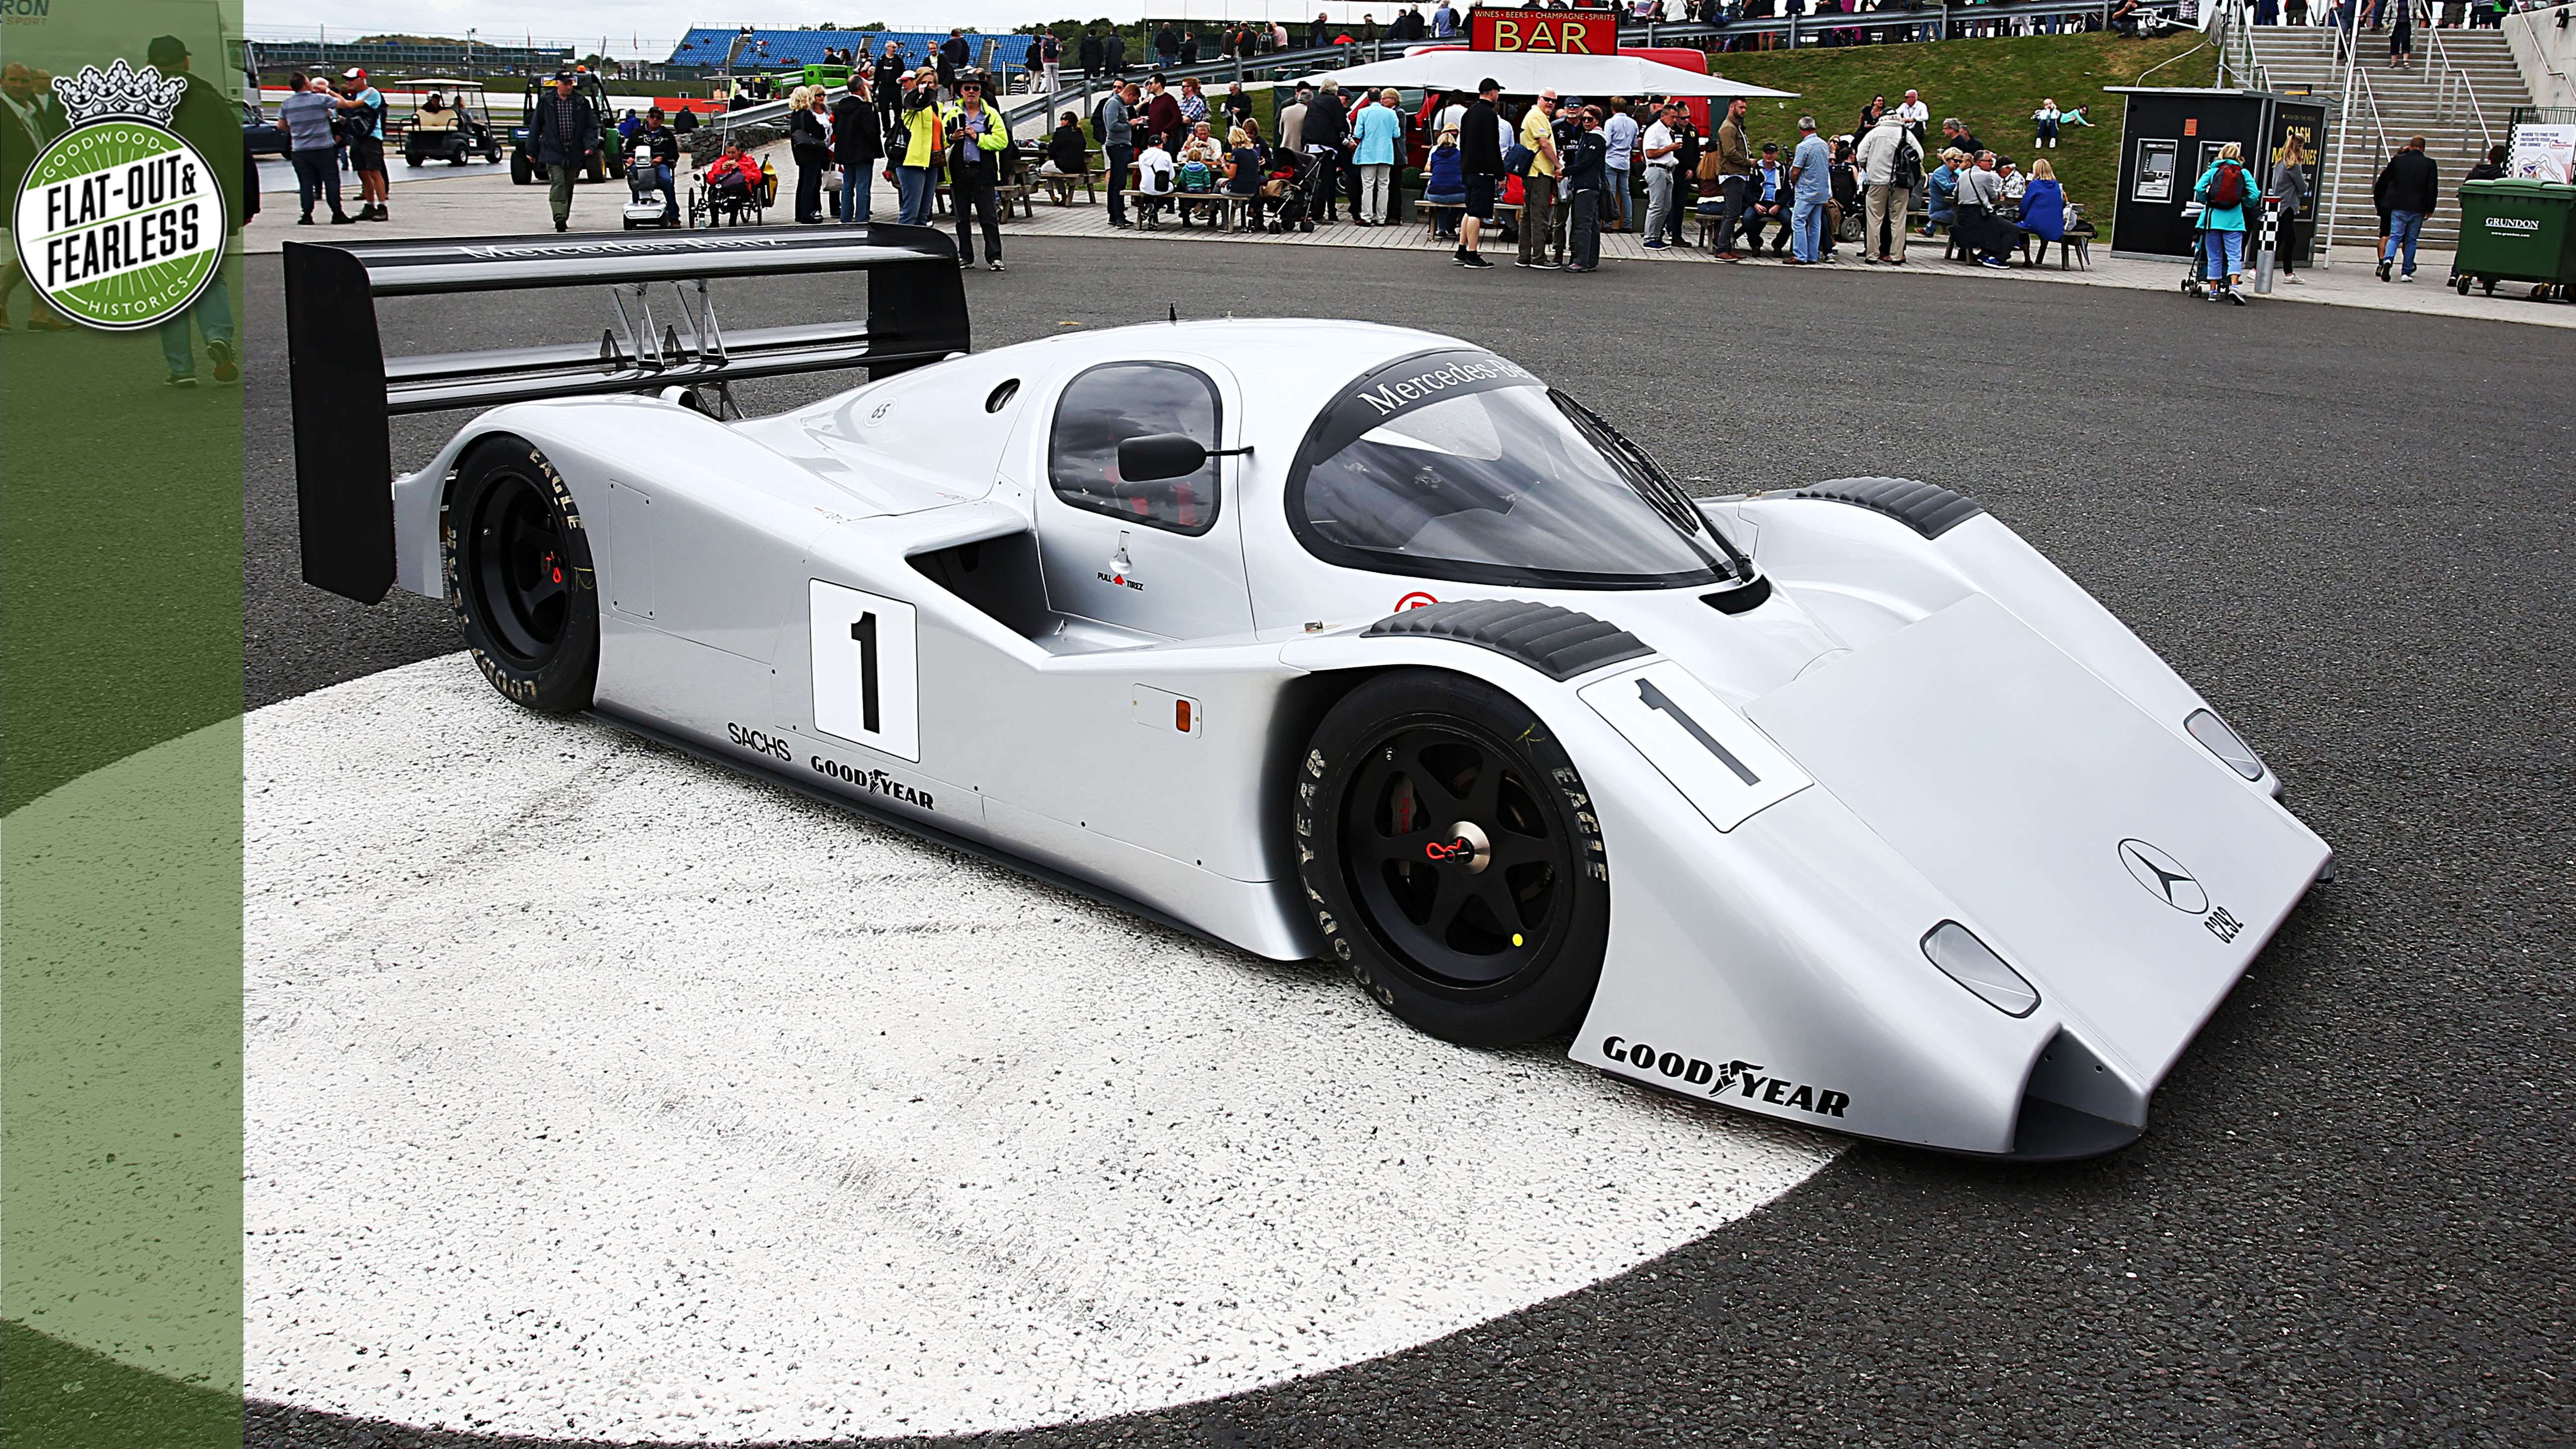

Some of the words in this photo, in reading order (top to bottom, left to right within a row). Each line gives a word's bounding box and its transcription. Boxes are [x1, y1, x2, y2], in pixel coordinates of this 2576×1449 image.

[6, 16, 47, 25] SPORT
[1495, 20, 1590, 54] BAR
[2271, 147, 2318, 166] MINES
[2486, 217, 2539, 229] GRUNDON
[459, 237, 788, 258] Mercedes-Benz
[871, 403, 891, 419] 65
[529, 448, 584, 530] EAGLE
[1097, 572, 1112, 583] PULL
[1126, 580, 1144, 592] TIREZ
[851, 610, 880, 735] 1
[727, 722, 792, 762] SACHS
[1634, 678, 1761, 786] 1
[1551, 767, 1607, 882] EAGLE
[2203, 906, 2245, 944] C292
